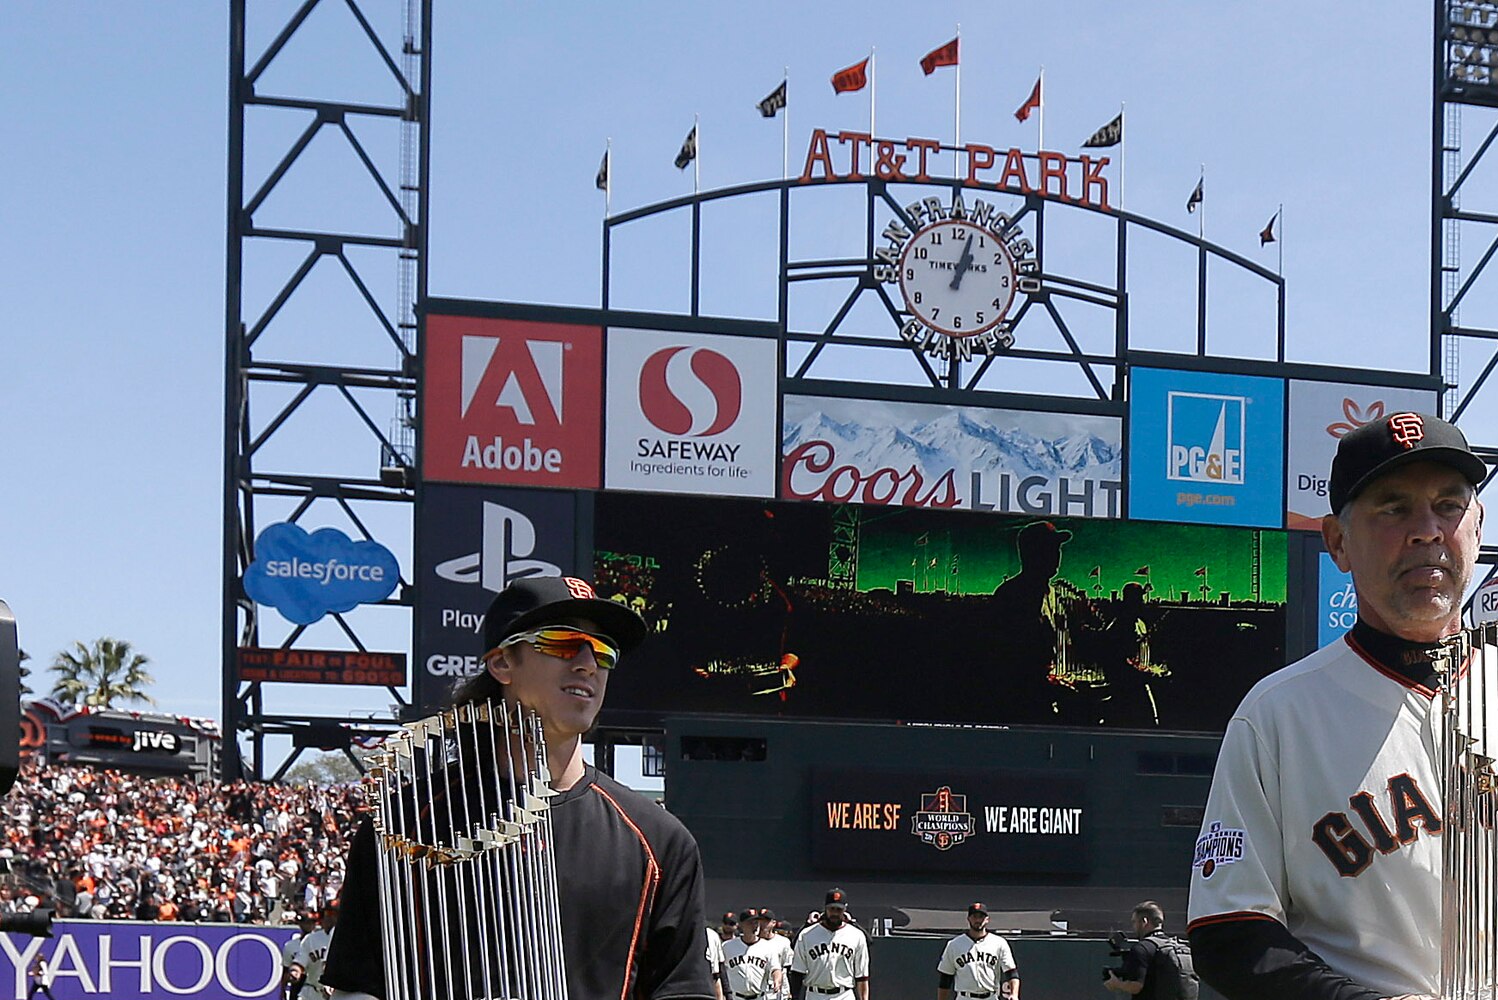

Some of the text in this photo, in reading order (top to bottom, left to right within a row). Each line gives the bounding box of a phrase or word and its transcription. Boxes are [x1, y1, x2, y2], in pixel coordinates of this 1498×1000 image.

[799, 129, 1112, 211] AT&T PARK
[931, 233, 942, 245] 11
[952, 228, 965, 240] 12
[979, 236, 985, 248] 1
[873, 195, 1040, 292] SAN FRANCISCO
[914, 247, 927, 260] 10
[994, 253, 1002, 265] 2
[906, 269, 914, 280] 9
[929, 261, 987, 273] TIMEWRKS
[1001, 276, 1009, 288] 3
[914, 292, 922, 304] 8
[992, 298, 1000, 310] 4
[932, 308, 939, 320] 7
[953, 316, 962, 328] 6
[976, 312, 984, 324] 5
[900, 319, 1015, 362] GIANTS
[461, 435, 562, 473] Adobe
[637, 438, 741, 463] SAFEWAY
[630, 460, 748, 479] Ingredients for life
[1172, 444, 1242, 481] PG&E
[782, 440, 1122, 518] Coors LIGHT
[1298, 475, 1330, 496] Dig
[1176, 492, 1235, 506] pge.com
[266, 557, 384, 585] salesforce
[442, 609, 485, 633] Play
[273, 651, 325, 667] FAIR
[345, 655, 395, 670] FOUL
[133, 731, 176, 752] jive
[827, 802, 901, 830] WE ARE SF
[928, 814, 959, 822] WORLD
[984, 806, 1082, 835] WE ARE GIANT
[918, 821, 968, 831] CHAMPIONS
[808, 941, 854, 961] GIANTS
[956, 950, 998, 968] GIANTS
[0, 933, 284, 1000] YAHOO
[729, 954, 767, 970] GIANTS
